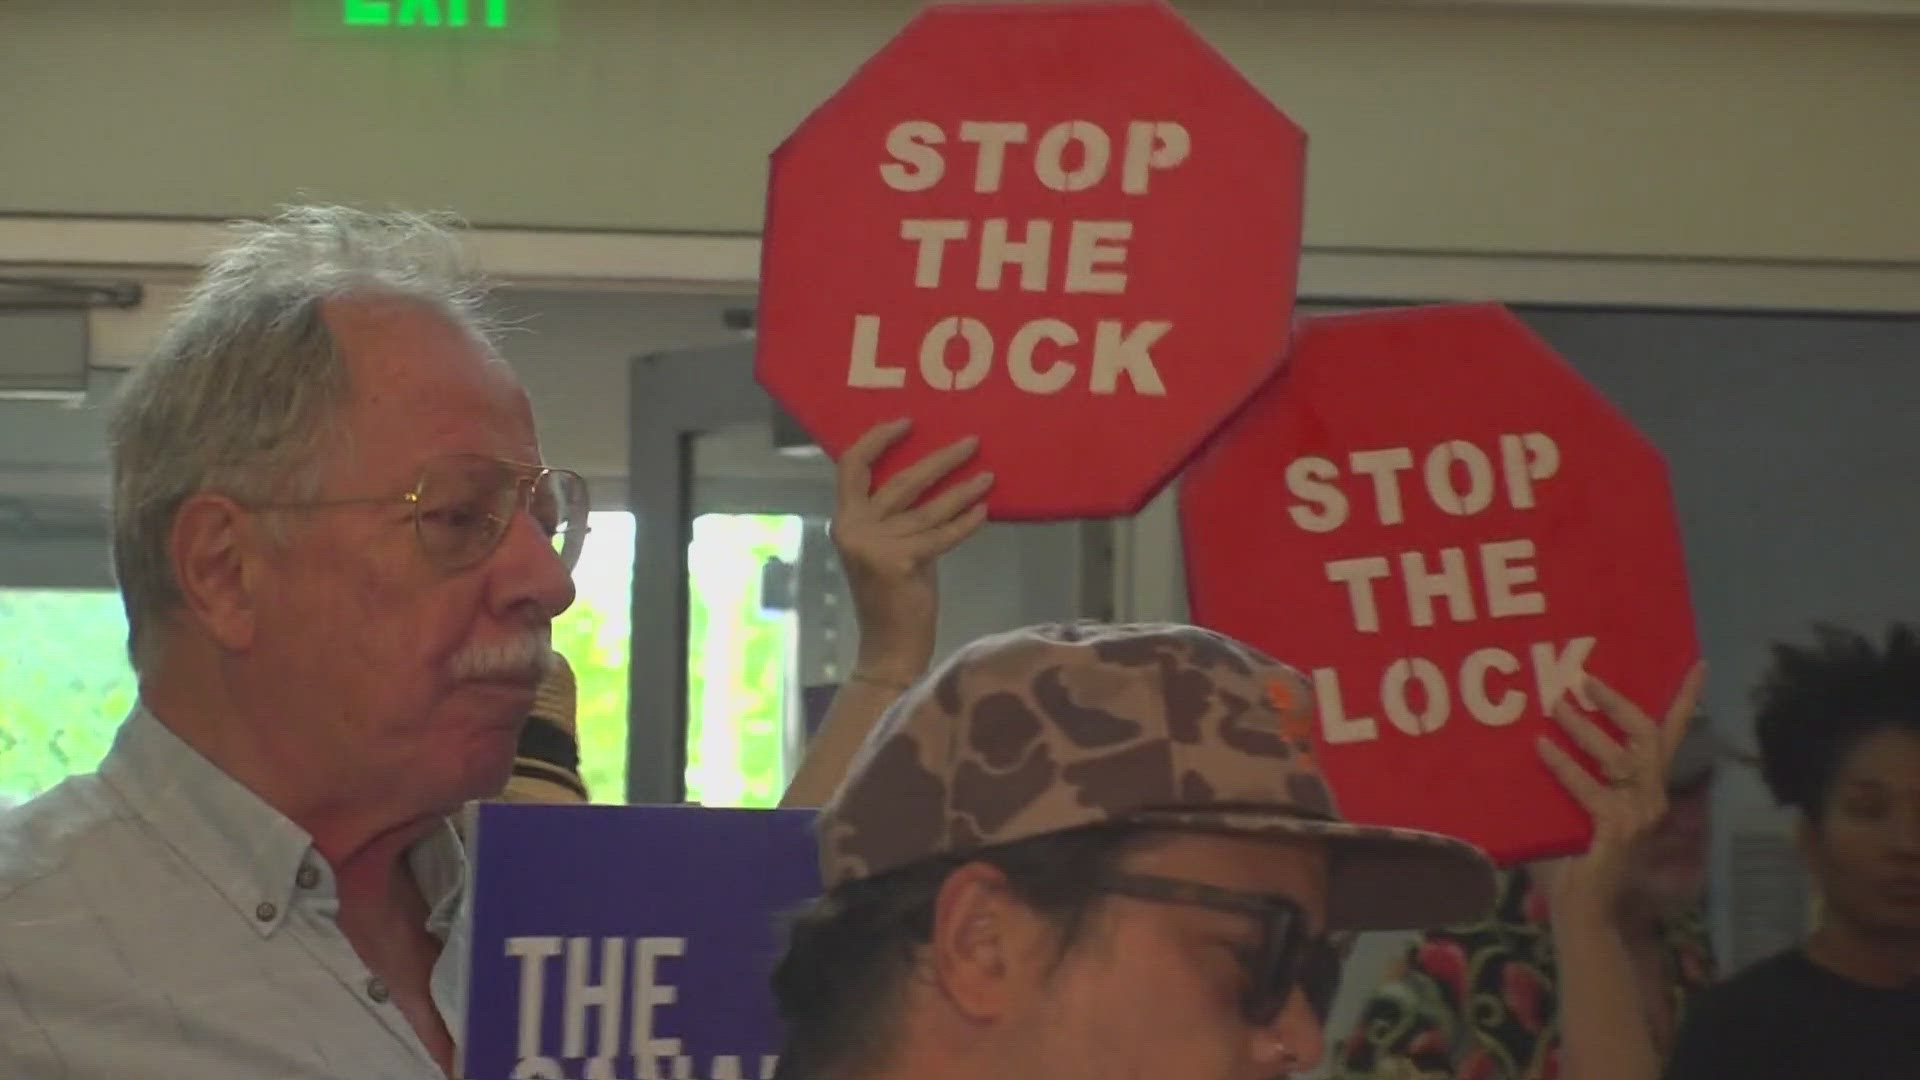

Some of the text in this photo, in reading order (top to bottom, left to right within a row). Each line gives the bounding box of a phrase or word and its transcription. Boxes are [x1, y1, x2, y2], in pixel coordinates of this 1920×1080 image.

[879, 120, 1191, 195] STOP
[900, 218, 1133, 294] THE
[847, 314, 1173, 396] LOCK
[1285, 432, 1560, 533] STOP
[1324, 538, 1546, 633] THE
[1311, 636, 1597, 745] LOCK
[504, 936, 687, 1058] THE
